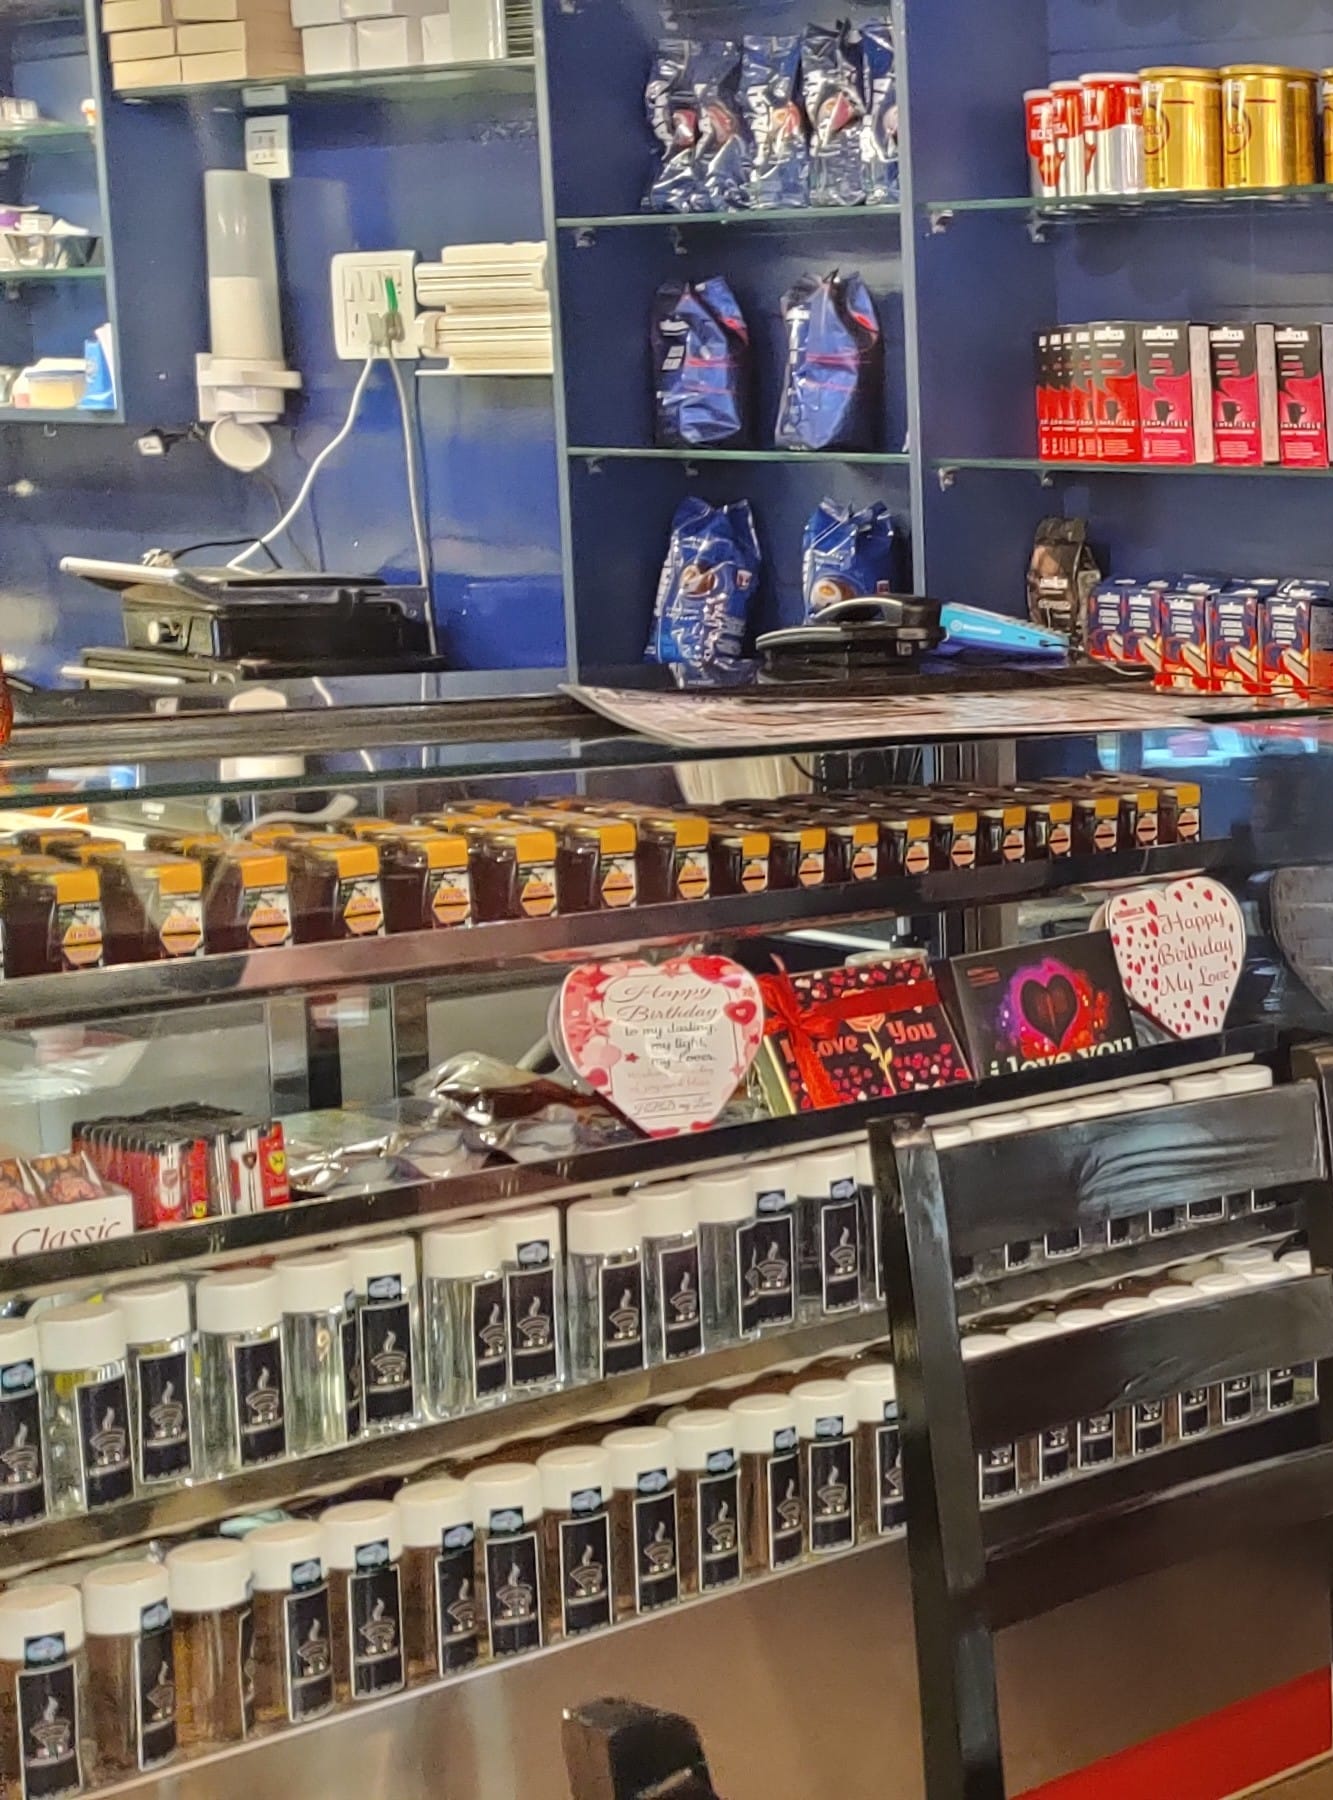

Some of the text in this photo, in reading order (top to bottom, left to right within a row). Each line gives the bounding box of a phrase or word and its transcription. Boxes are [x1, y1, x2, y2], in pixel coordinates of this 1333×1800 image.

[1157, 911, 1225, 936] Happy
[1157, 935, 1233, 967] Birthday
[622, 984, 714, 1002] Happy
[1159, 965, 1230, 997] My Love
[616, 1003, 723, 1023] Birthday
[779, 1019, 938, 1064] I ove You
[990, 1060, 1000, 1076] i
[12, 1217, 121, 1257] Classic
